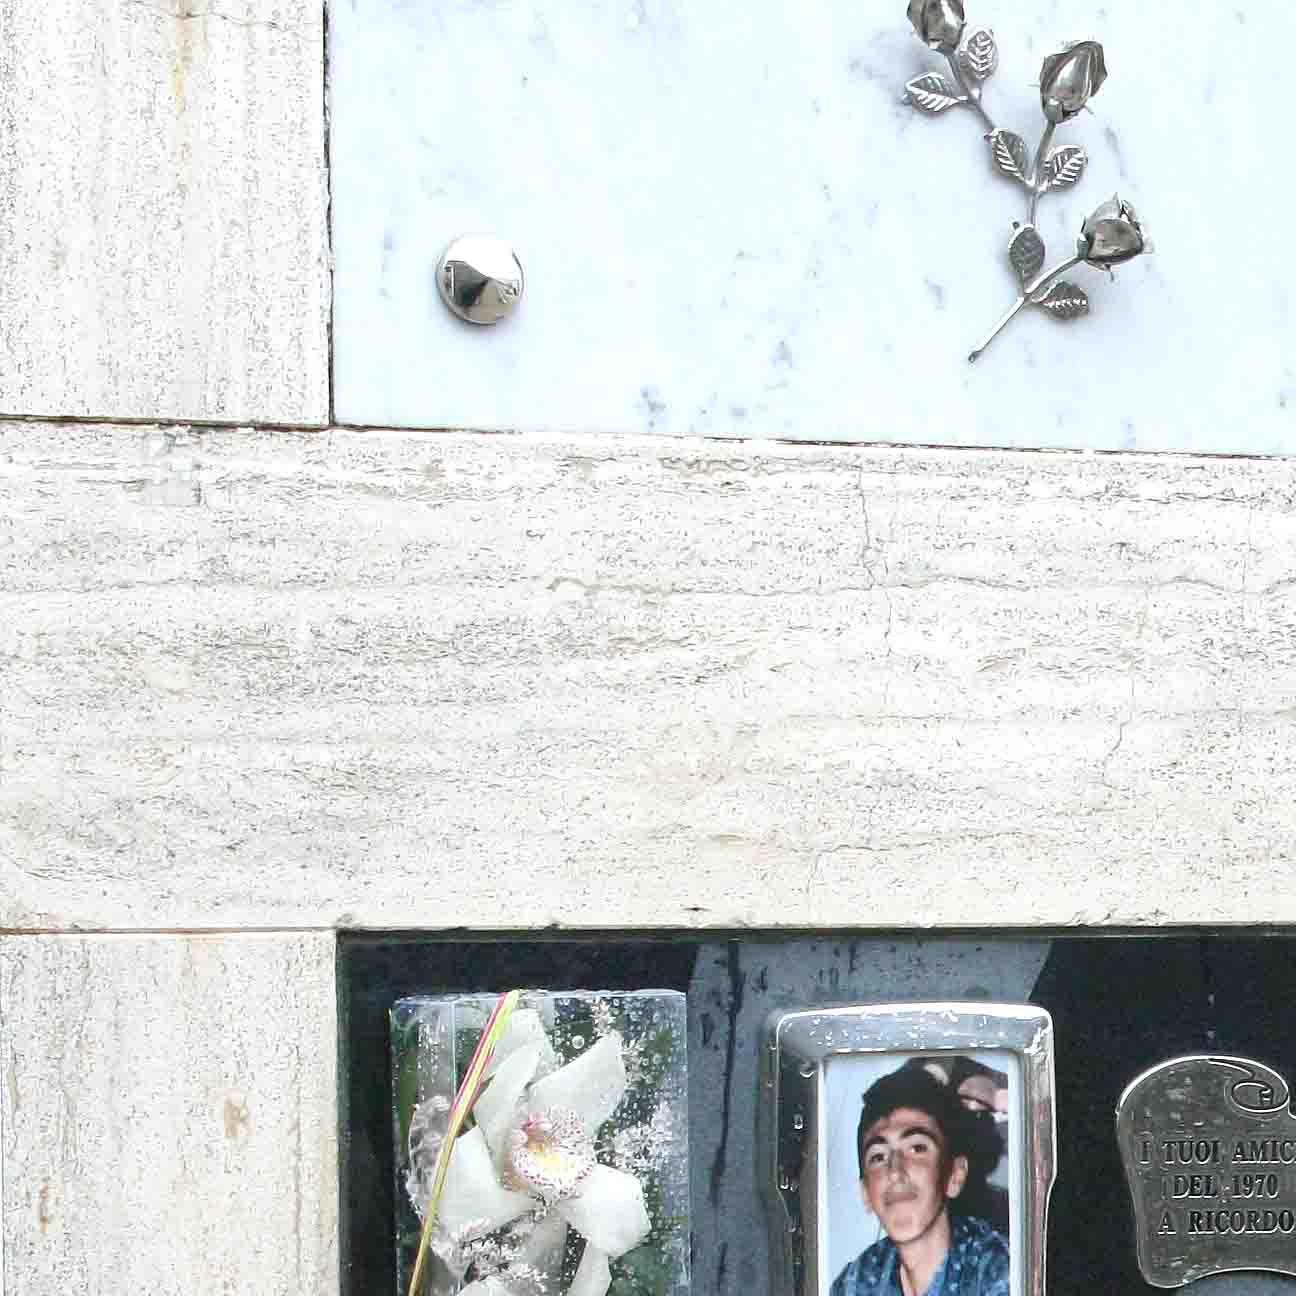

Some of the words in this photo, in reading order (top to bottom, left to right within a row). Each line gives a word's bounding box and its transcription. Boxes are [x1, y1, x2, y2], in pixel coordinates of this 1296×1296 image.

[1162, 1140, 1220, 1164] TUOI
[1171, 1174, 1219, 1200] DEL
[1231, 1174, 1279, 1200] 1970
[1157, 1210, 1177, 1235] A
[1187, 1210, 1296, 1235] RICORDO
